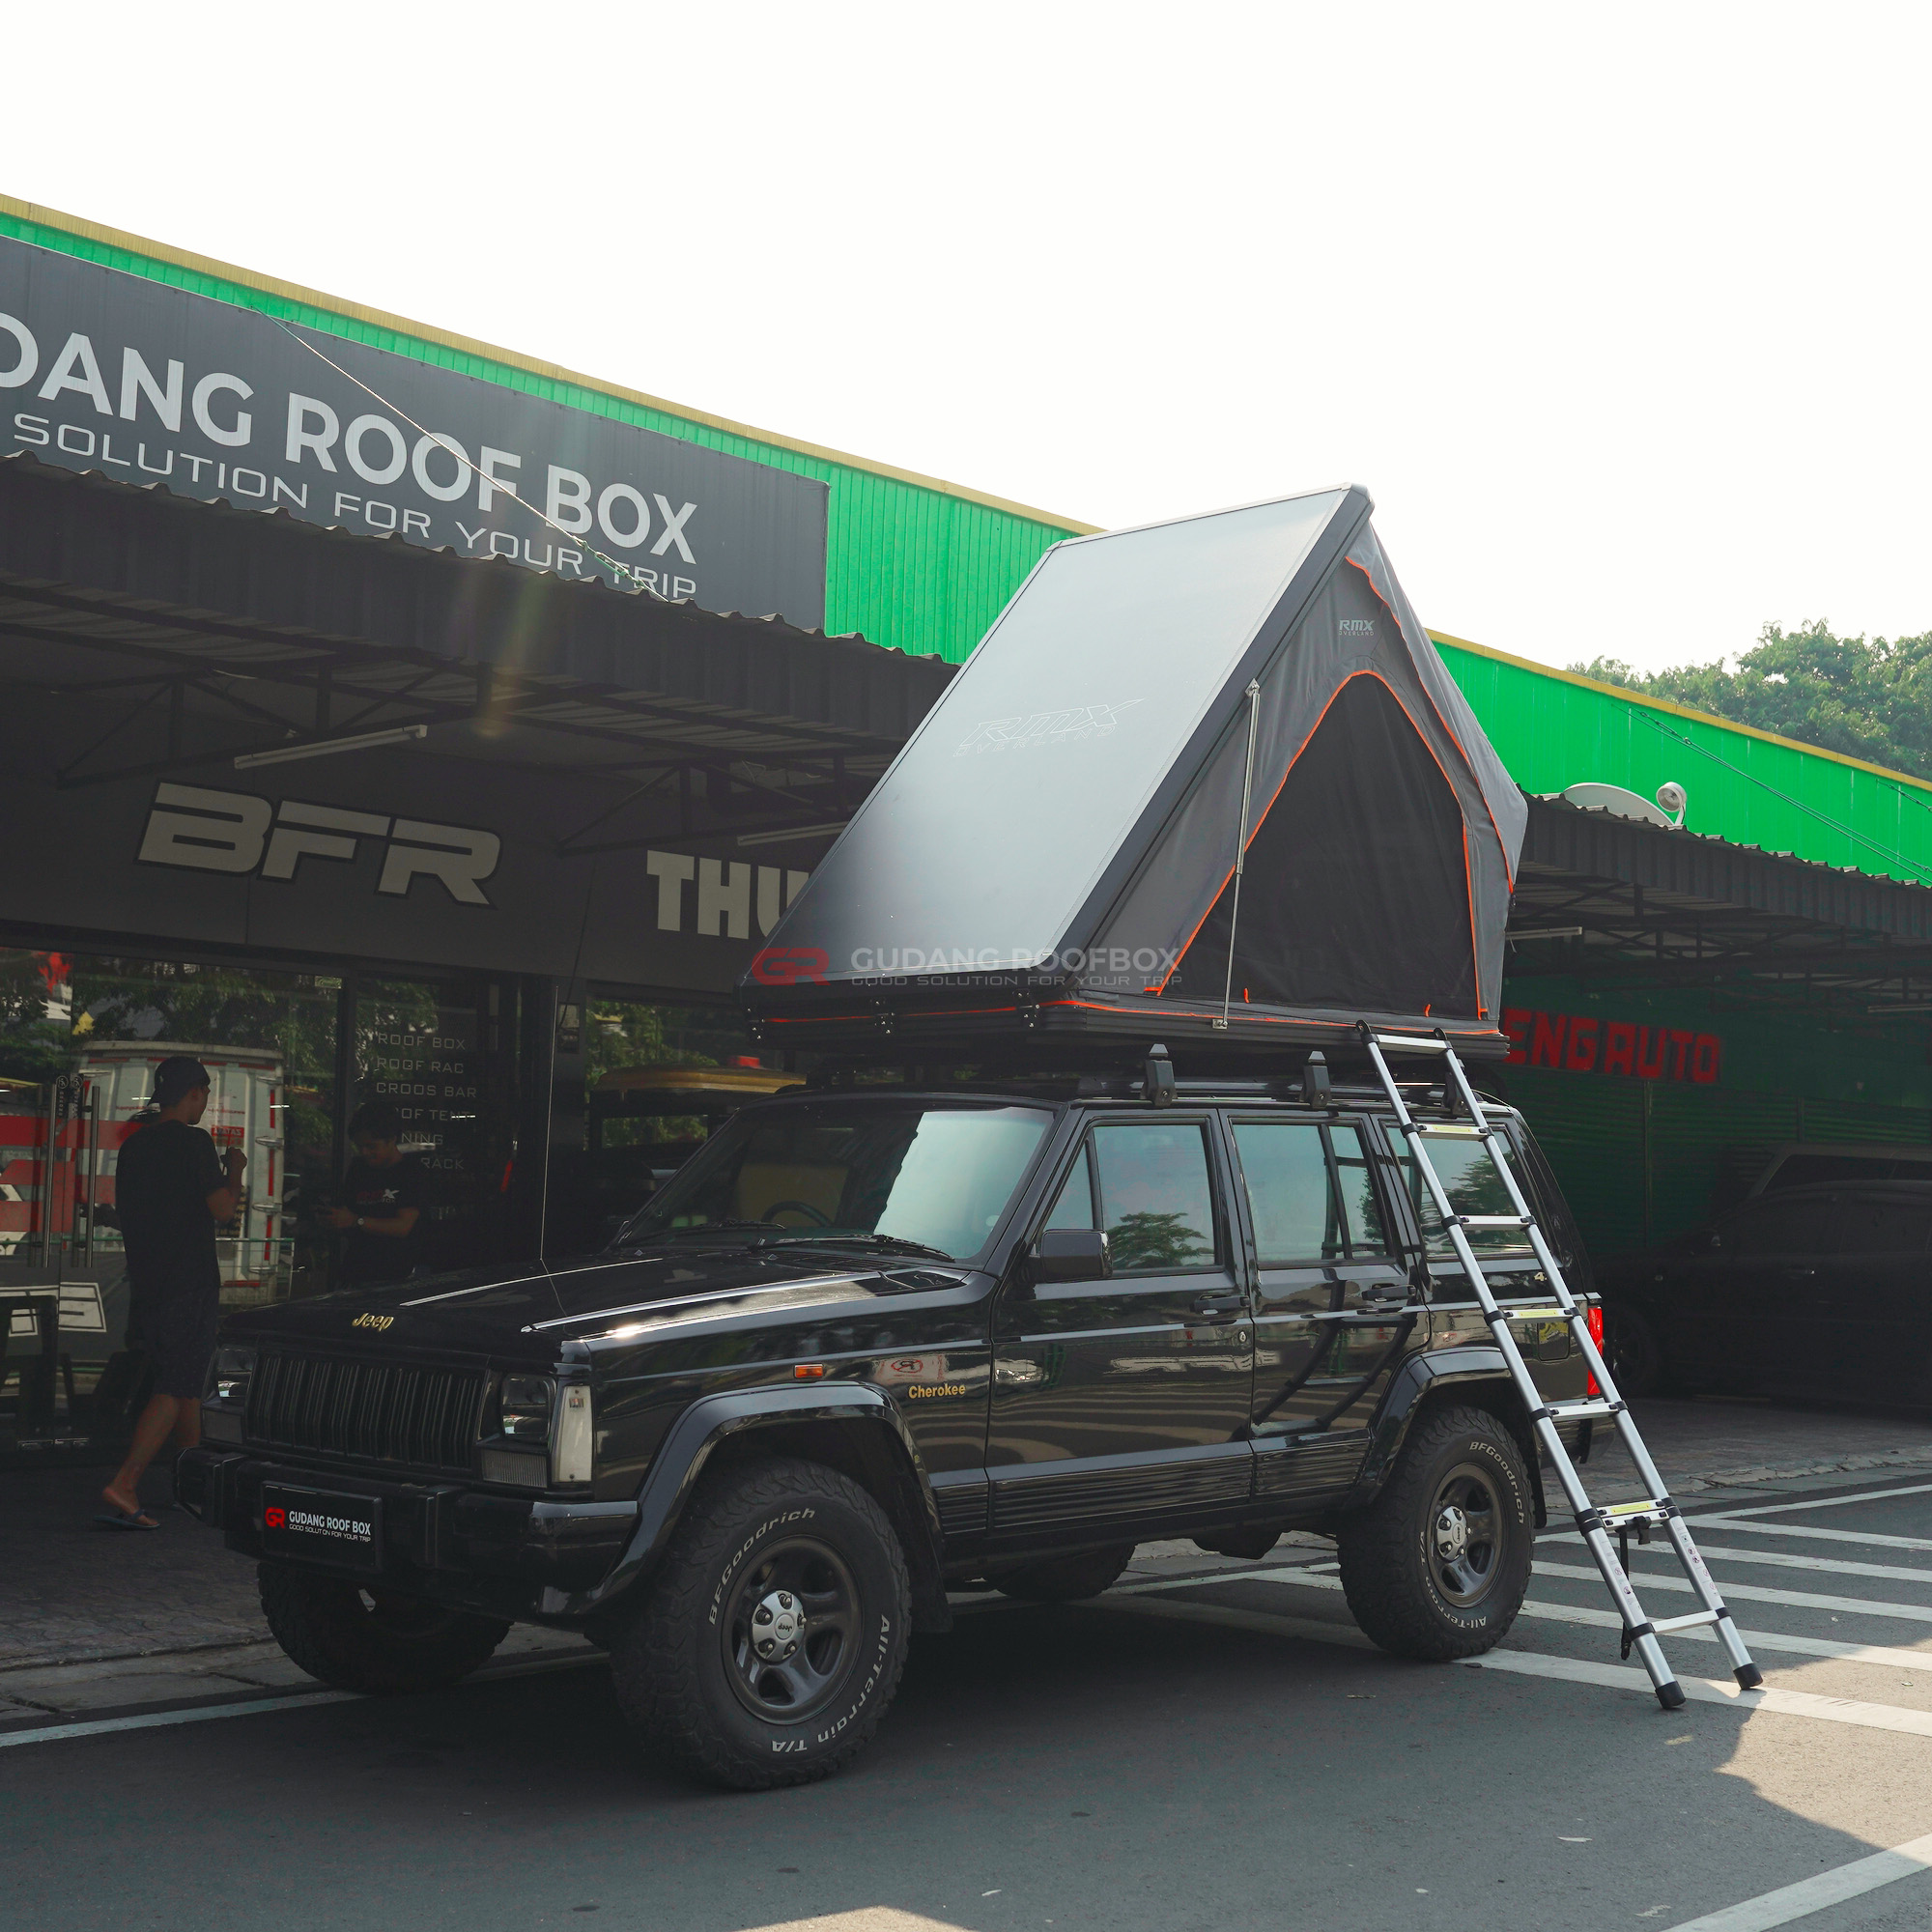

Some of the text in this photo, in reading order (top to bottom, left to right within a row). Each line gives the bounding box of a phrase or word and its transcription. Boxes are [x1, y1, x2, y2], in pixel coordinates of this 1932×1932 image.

[286, 392, 522, 512] ROOF
[546, 465, 697, 564] BOX
[14, 412, 696, 601] SOLUTION FOR YOUR TRIP
[1339, 619, 1375, 631] RMX
[136, 781, 501, 906] BFR
[378, 1033, 465, 1050] ROOF BOX
[377, 1057, 425, 1070] ROOF
[376, 1082, 477, 1097] CROOS BAR
[352, 1312, 394, 1332] Jeep
[908, 1383, 966, 1399] Cherokee
[1468, 1441, 1525, 1524] BFGoodrich
[289, 1511, 371, 1535] GUDANG ROOF BOX
[304, 1526, 330, 1536] SOLUTON
[708, 1508, 815, 1625] BFGoodrich
[772, 1614, 891, 1752] All-Terrain T/A
